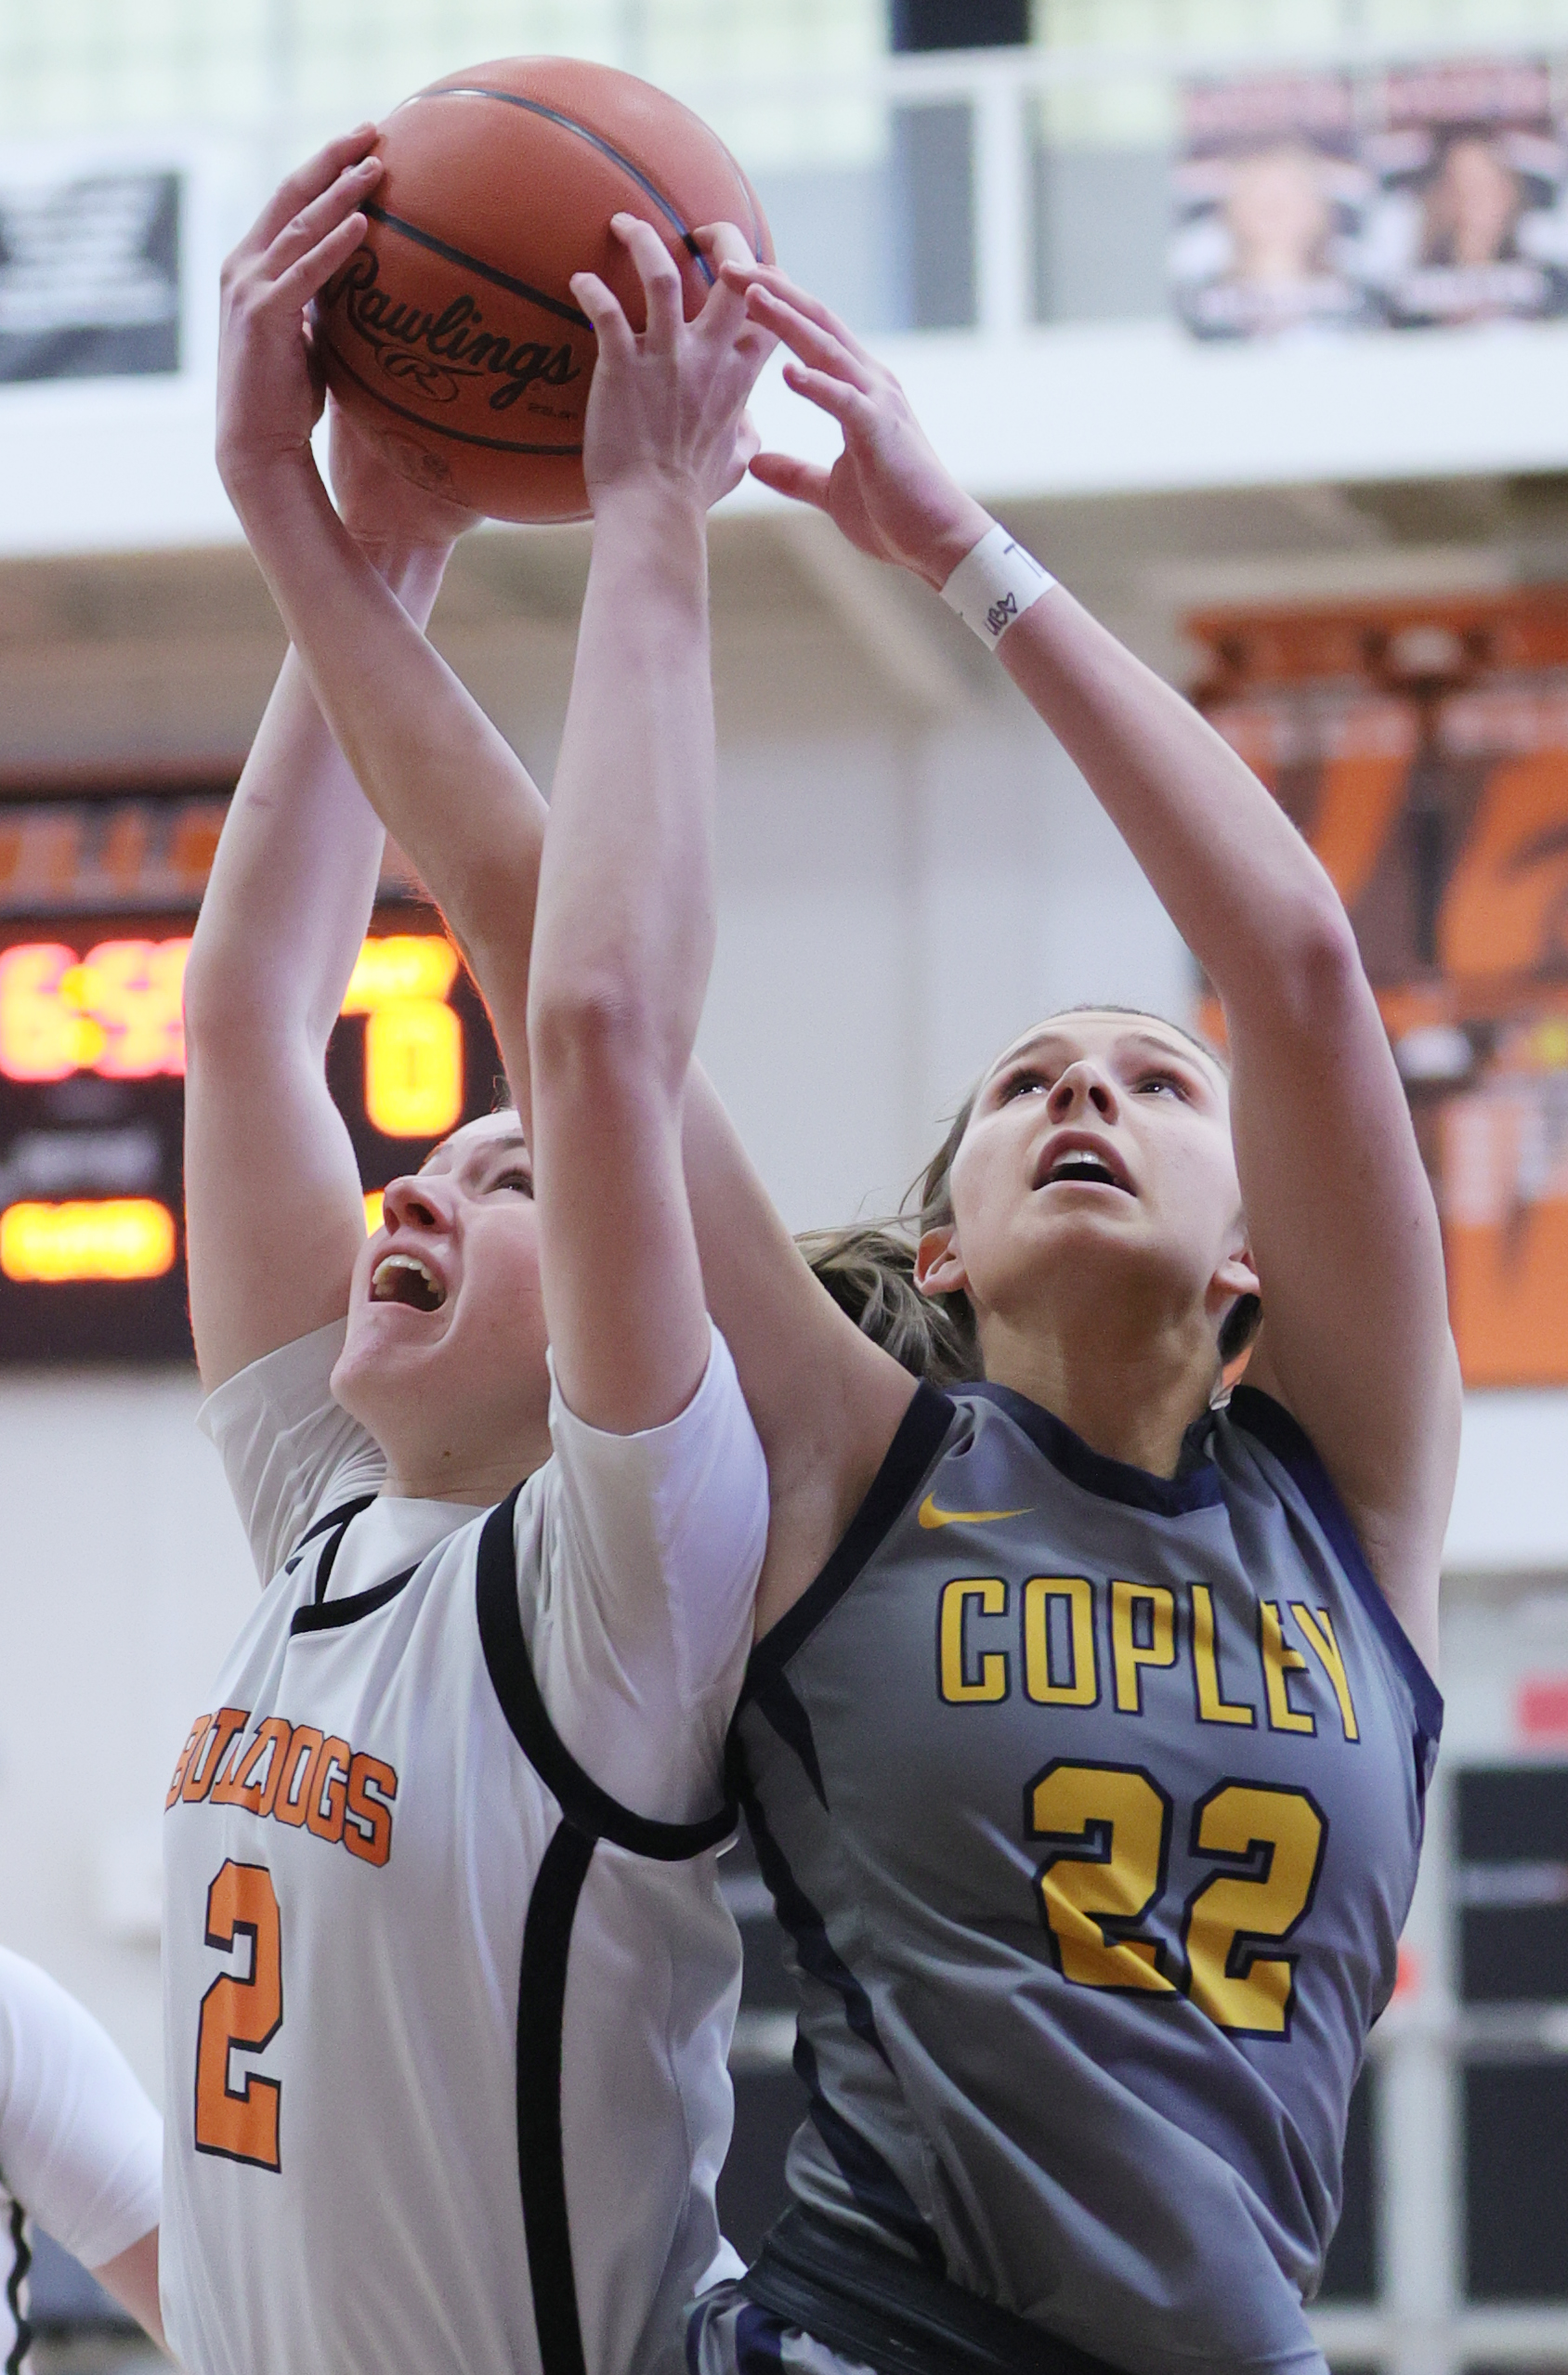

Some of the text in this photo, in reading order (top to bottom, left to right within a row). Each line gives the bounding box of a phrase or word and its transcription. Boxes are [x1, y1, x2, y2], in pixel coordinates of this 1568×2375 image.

[326, 245, 581, 411] Rawlings
[937, 1574, 1361, 1744] COPLEY
[1023, 1756, 1330, 2042] 22
[194, 1858, 283, 2174] 2
